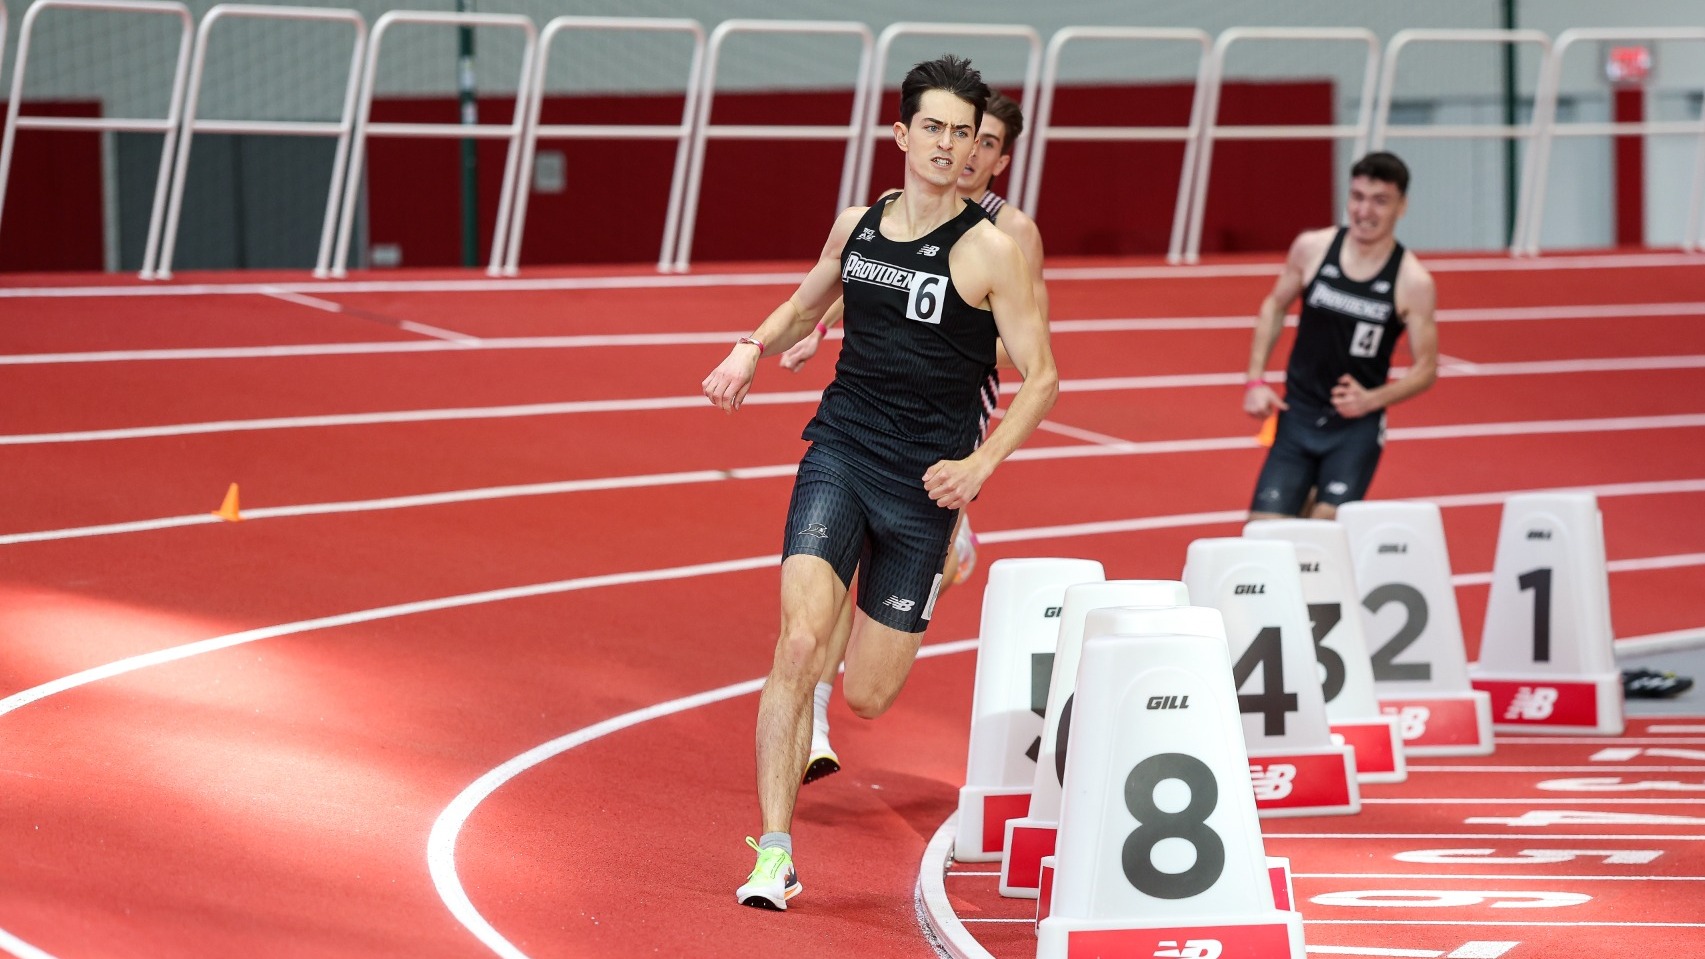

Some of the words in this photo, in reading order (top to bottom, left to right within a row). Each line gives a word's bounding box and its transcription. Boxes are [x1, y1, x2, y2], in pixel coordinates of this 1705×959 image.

[842, 254, 913, 289] PROVIDEN
[915, 277, 940, 319] 6
[1357, 329, 1374, 351] 4
[1234, 584, 1266, 595] GILL
[1044, 606, 1063, 618] GI
[1362, 582, 1432, 680] 2
[1518, 568, 1552, 663] 1
[1232, 627, 1298, 736] 4
[1146, 695, 1189, 710] GILL
[1122, 753, 1226, 900] 8
